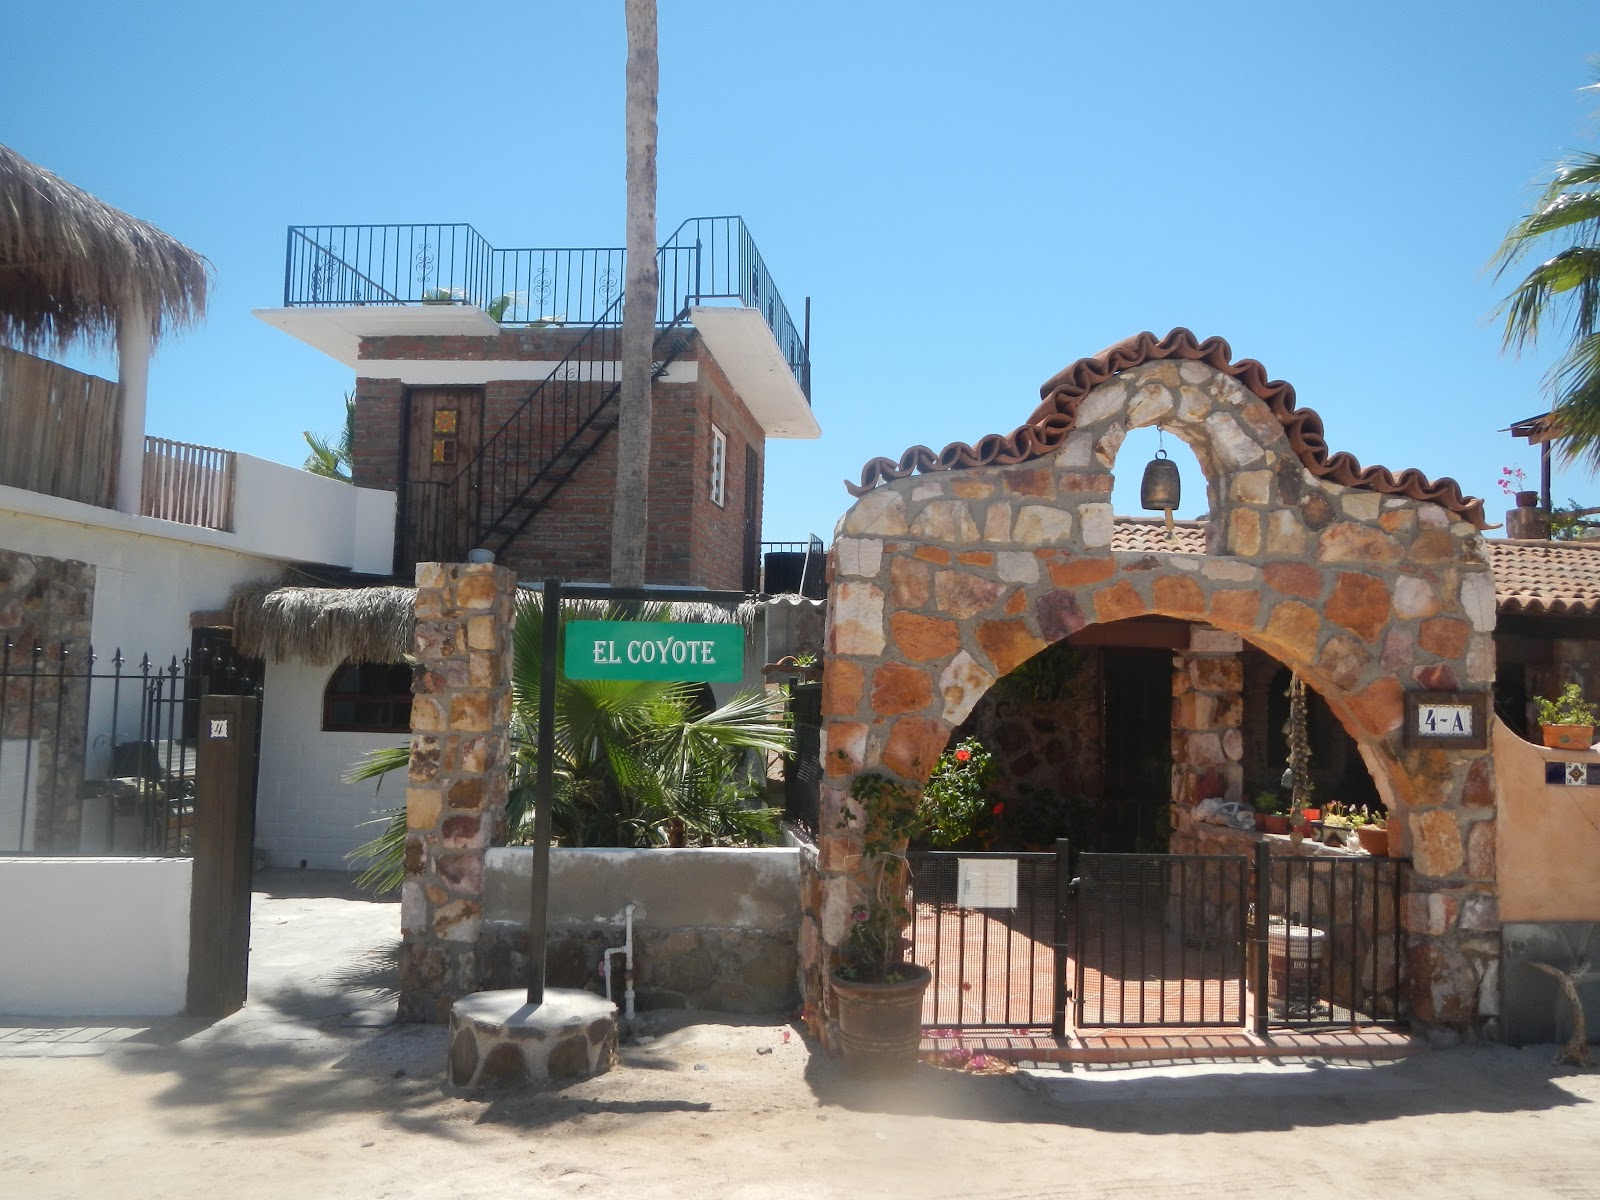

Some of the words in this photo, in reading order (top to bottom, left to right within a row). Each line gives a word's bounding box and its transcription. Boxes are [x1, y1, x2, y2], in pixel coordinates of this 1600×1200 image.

[593, 640, 622, 664] EL
[627, 636, 716, 664] COYOTE
[1425, 709, 1464, 731] 4-A
